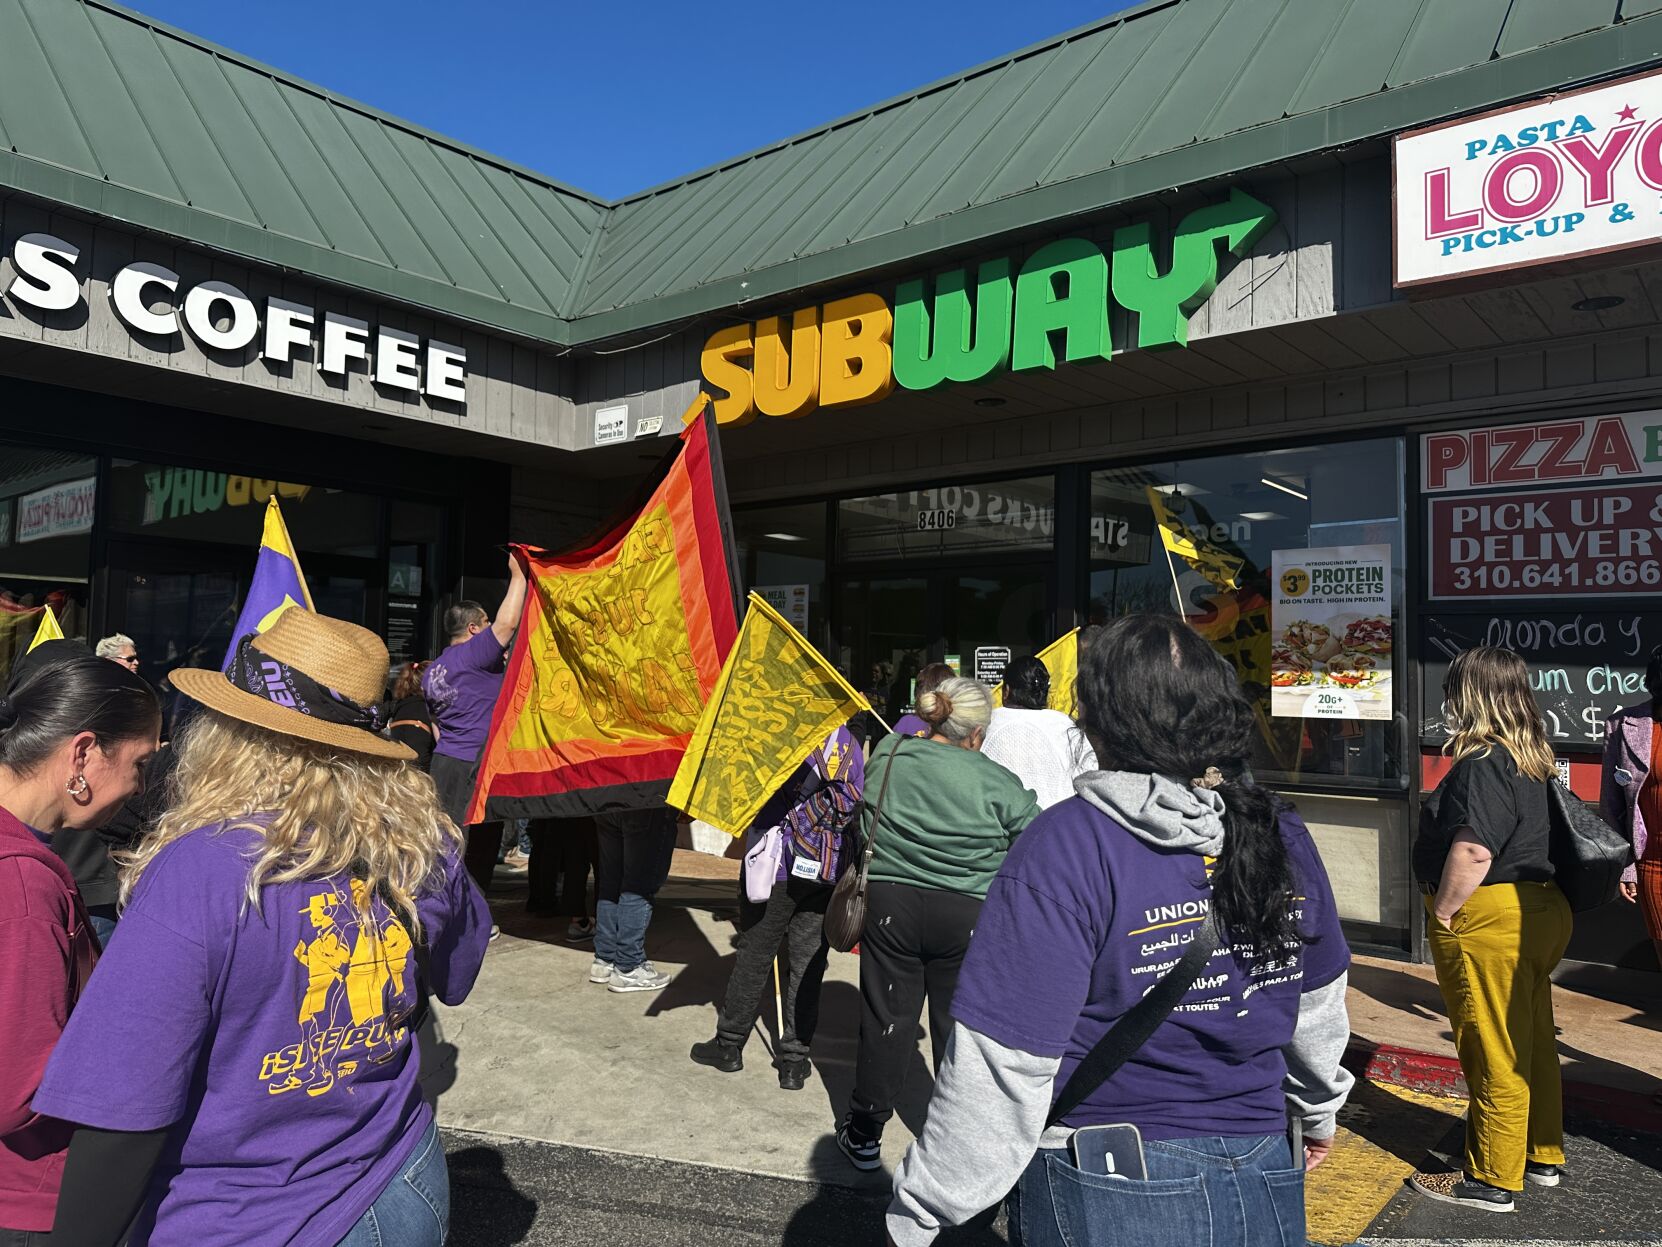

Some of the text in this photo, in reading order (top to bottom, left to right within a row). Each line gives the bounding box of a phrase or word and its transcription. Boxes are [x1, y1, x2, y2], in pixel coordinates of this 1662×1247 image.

[1465, 114, 1596, 160] PASTA
[1441, 212, 1585, 256] PICK-UP
[1608, 203, 1635, 223] &
[0, 232, 467, 403] S COFFEE
[701, 186, 1278, 426] SUBWAY
[1427, 416, 1643, 490] PIZZA
[919, 510, 955, 529] 8406
[1452, 501, 1554, 533] PICK
[1570, 497, 1633, 526] UP
[1312, 567, 1384, 584] PROTEIN
[1312, 583, 1384, 595] POCKETS
[768, 590, 786, 600] MEAL
[1529, 668, 1574, 694] um
[1185, 1003, 1219, 1012] TOUTES
